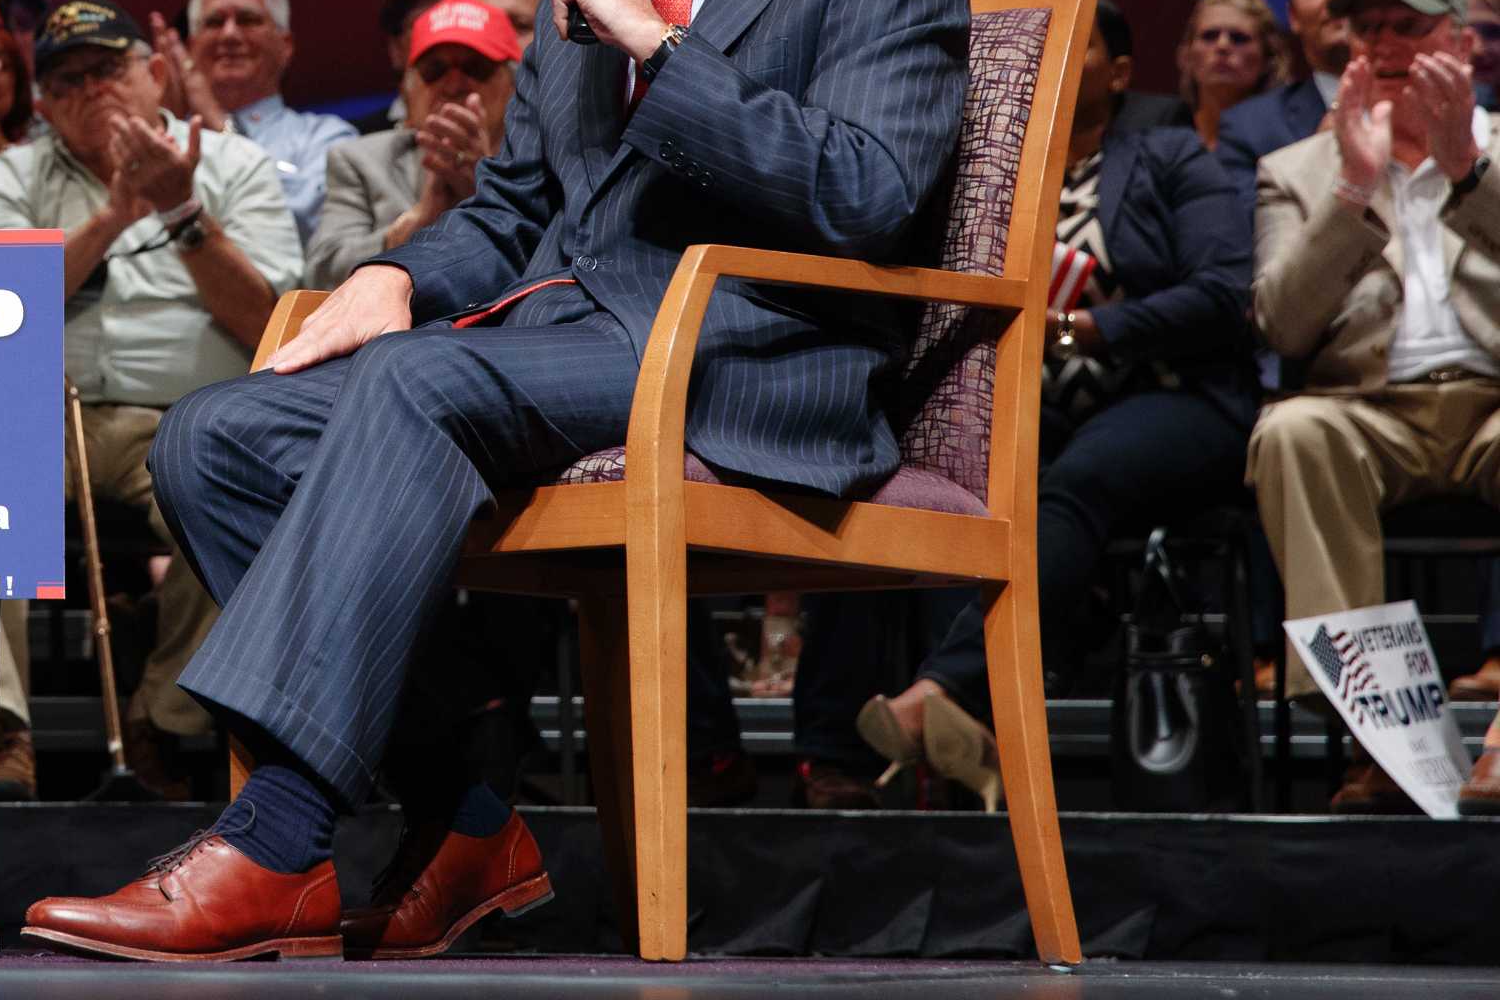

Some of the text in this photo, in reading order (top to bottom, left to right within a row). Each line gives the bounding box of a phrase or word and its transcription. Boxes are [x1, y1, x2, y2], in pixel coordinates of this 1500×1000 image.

[1353, 621, 1423, 653] VETERANS
[1404, 651, 1432, 677] FOR
[1354, 683, 1443, 730] TRUMP
